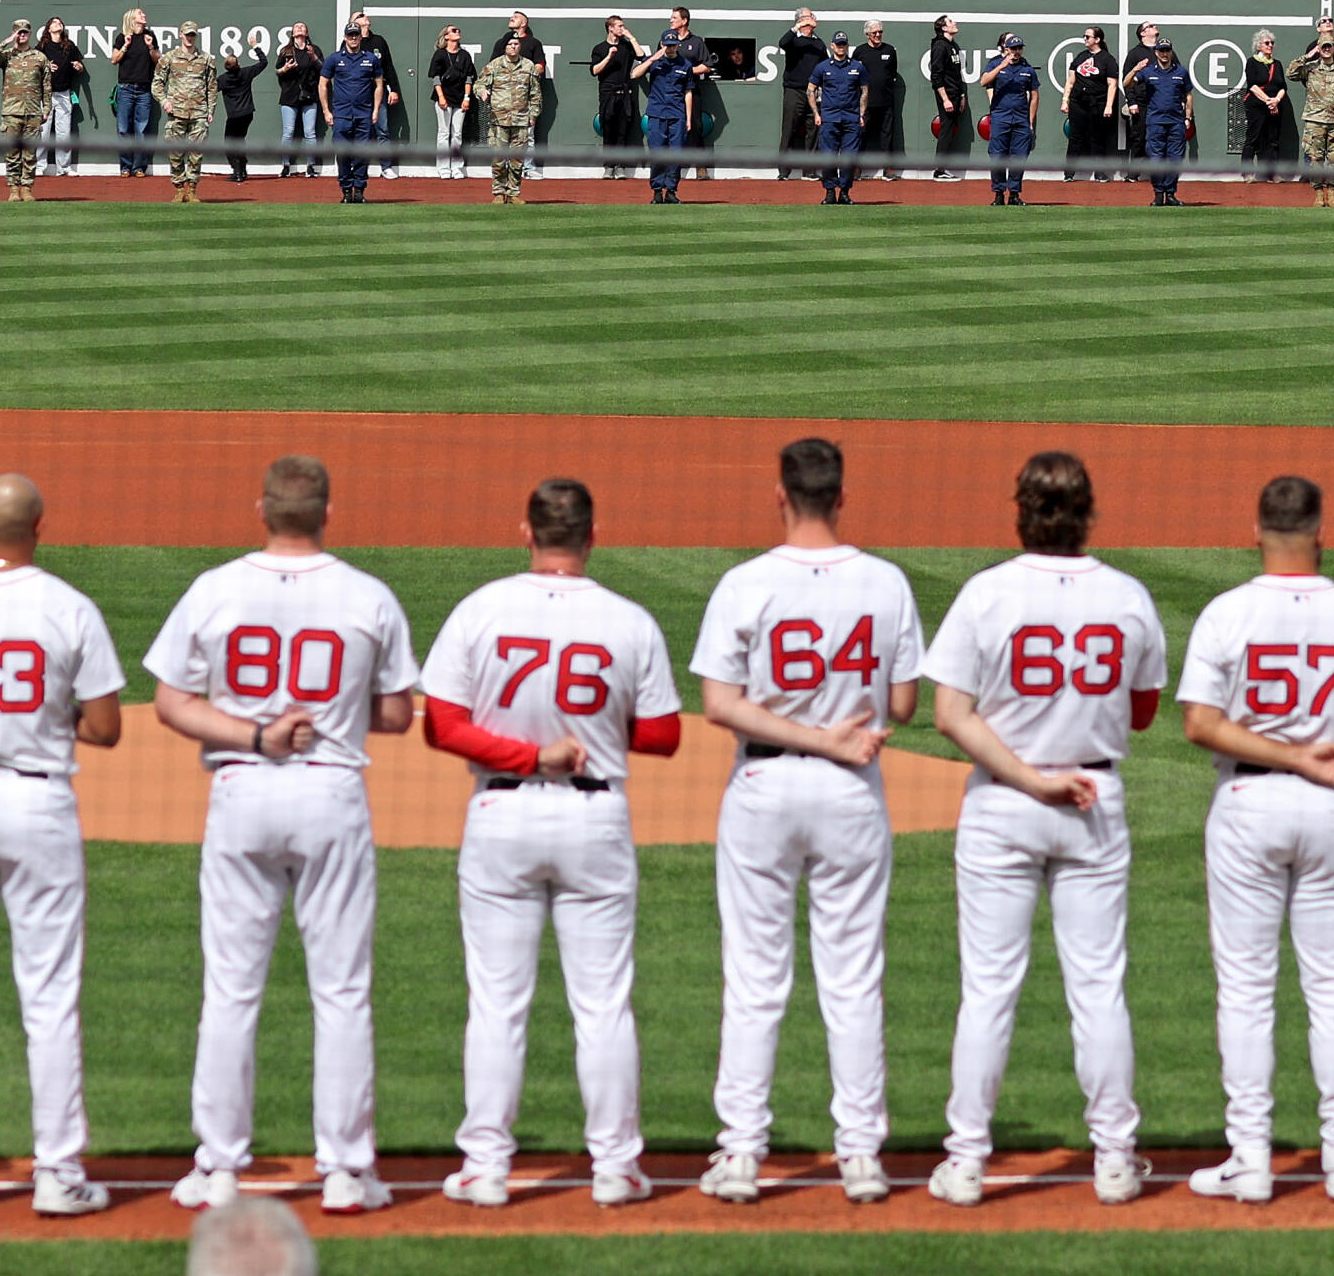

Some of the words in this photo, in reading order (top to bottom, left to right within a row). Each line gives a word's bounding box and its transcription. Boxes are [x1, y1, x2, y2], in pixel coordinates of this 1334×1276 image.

[1209, 53, 1229, 85] E
[227, 626, 344, 702] 80
[497, 636, 613, 715] 76
[771, 615, 879, 691] 64
[1011, 625, 1124, 696] 63
